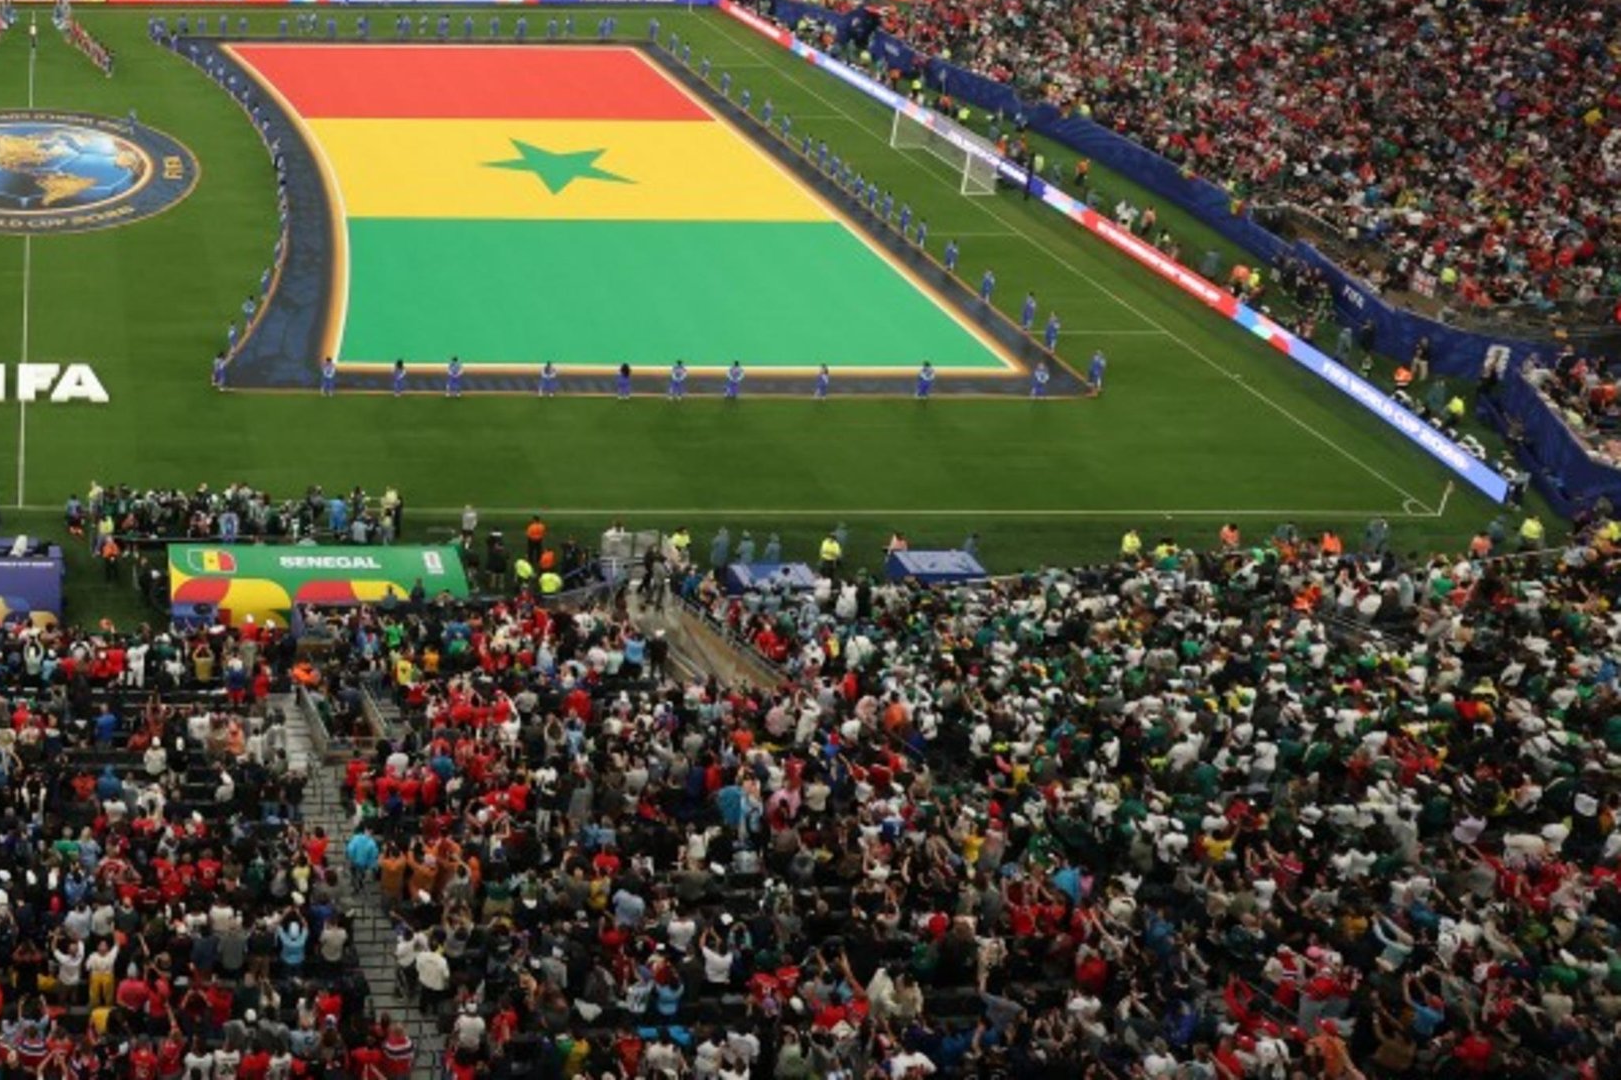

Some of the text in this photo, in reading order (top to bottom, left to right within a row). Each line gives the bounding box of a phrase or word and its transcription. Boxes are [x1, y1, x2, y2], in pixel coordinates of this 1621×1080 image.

[1341, 284, 1365, 309] FIFA
[1323, 362, 1350, 386] FIFA
[1349, 379, 1395, 415] WORLD
[1393, 410, 1421, 433] CUP
[279, 555, 381, 569] SENEGAL
